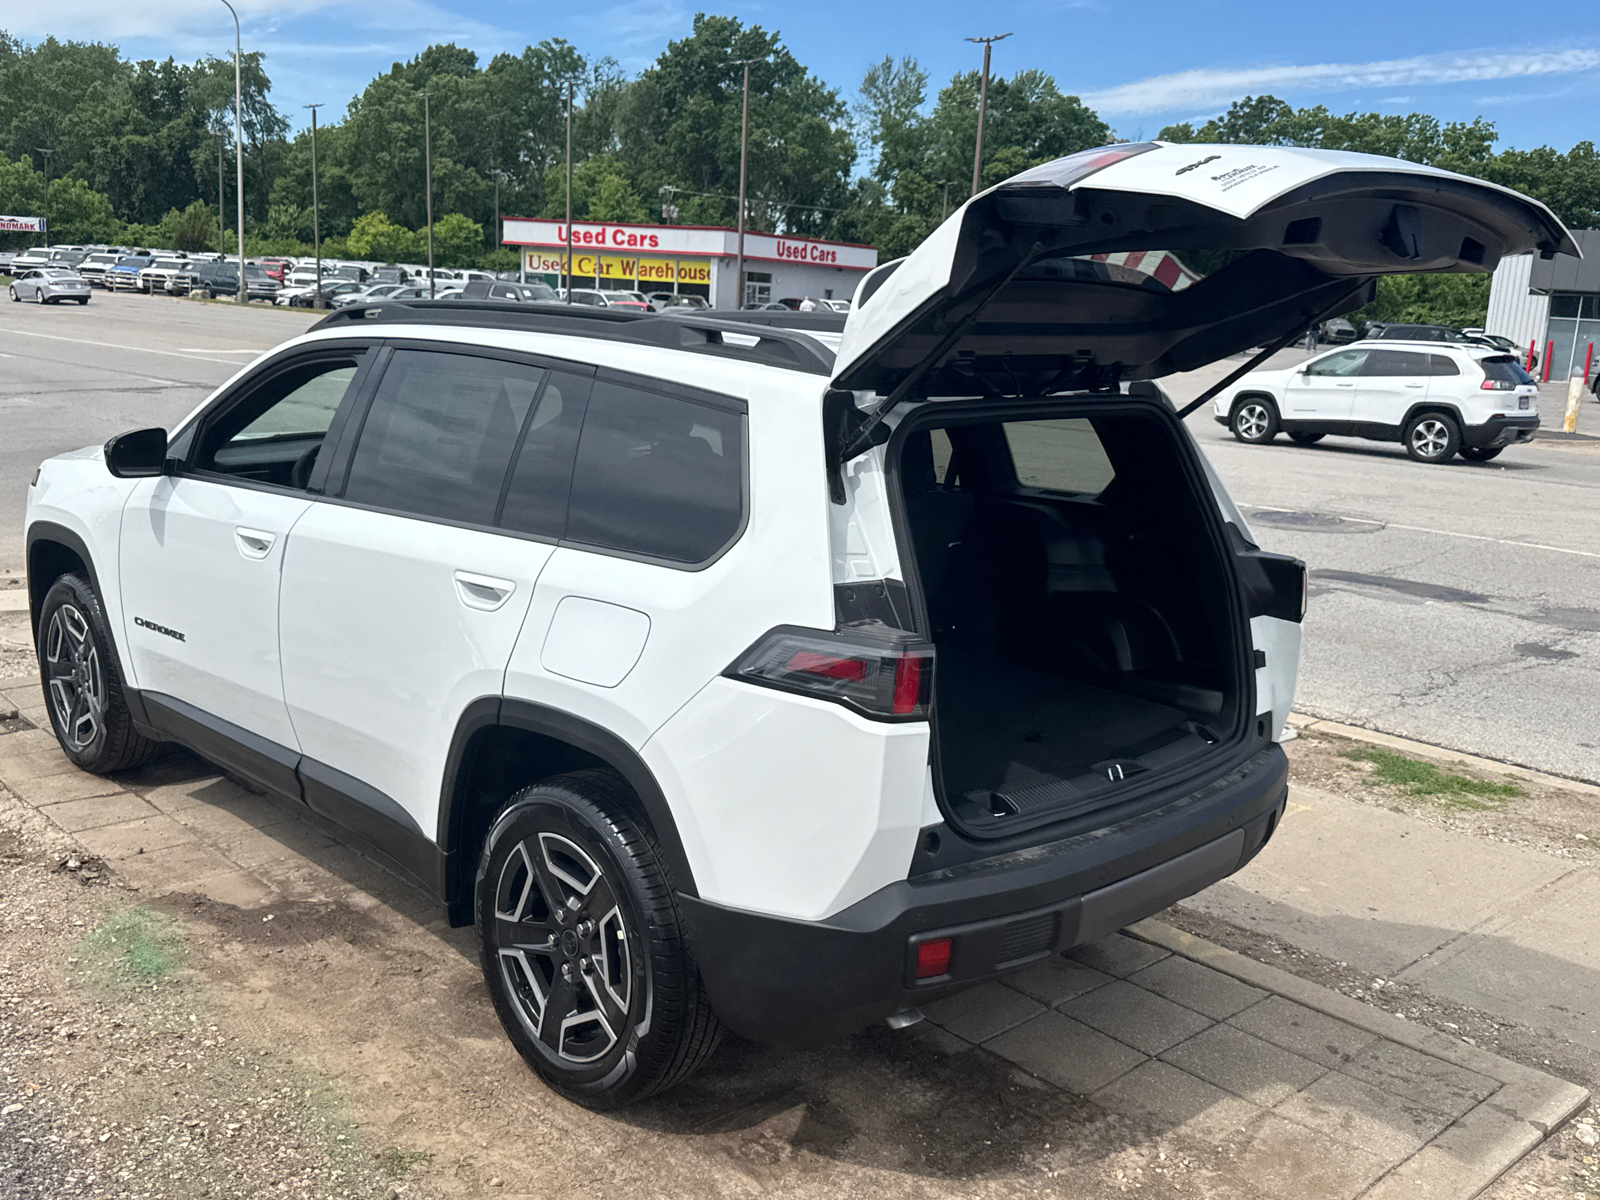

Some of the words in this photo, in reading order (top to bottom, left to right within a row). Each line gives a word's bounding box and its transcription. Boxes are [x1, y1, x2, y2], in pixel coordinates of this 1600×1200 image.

[558, 226, 606, 245] Used
[612, 229, 659, 248] Cars
[777, 240, 807, 260] Used
[810, 245, 837, 263] Cars
[578, 257, 613, 275] Car
